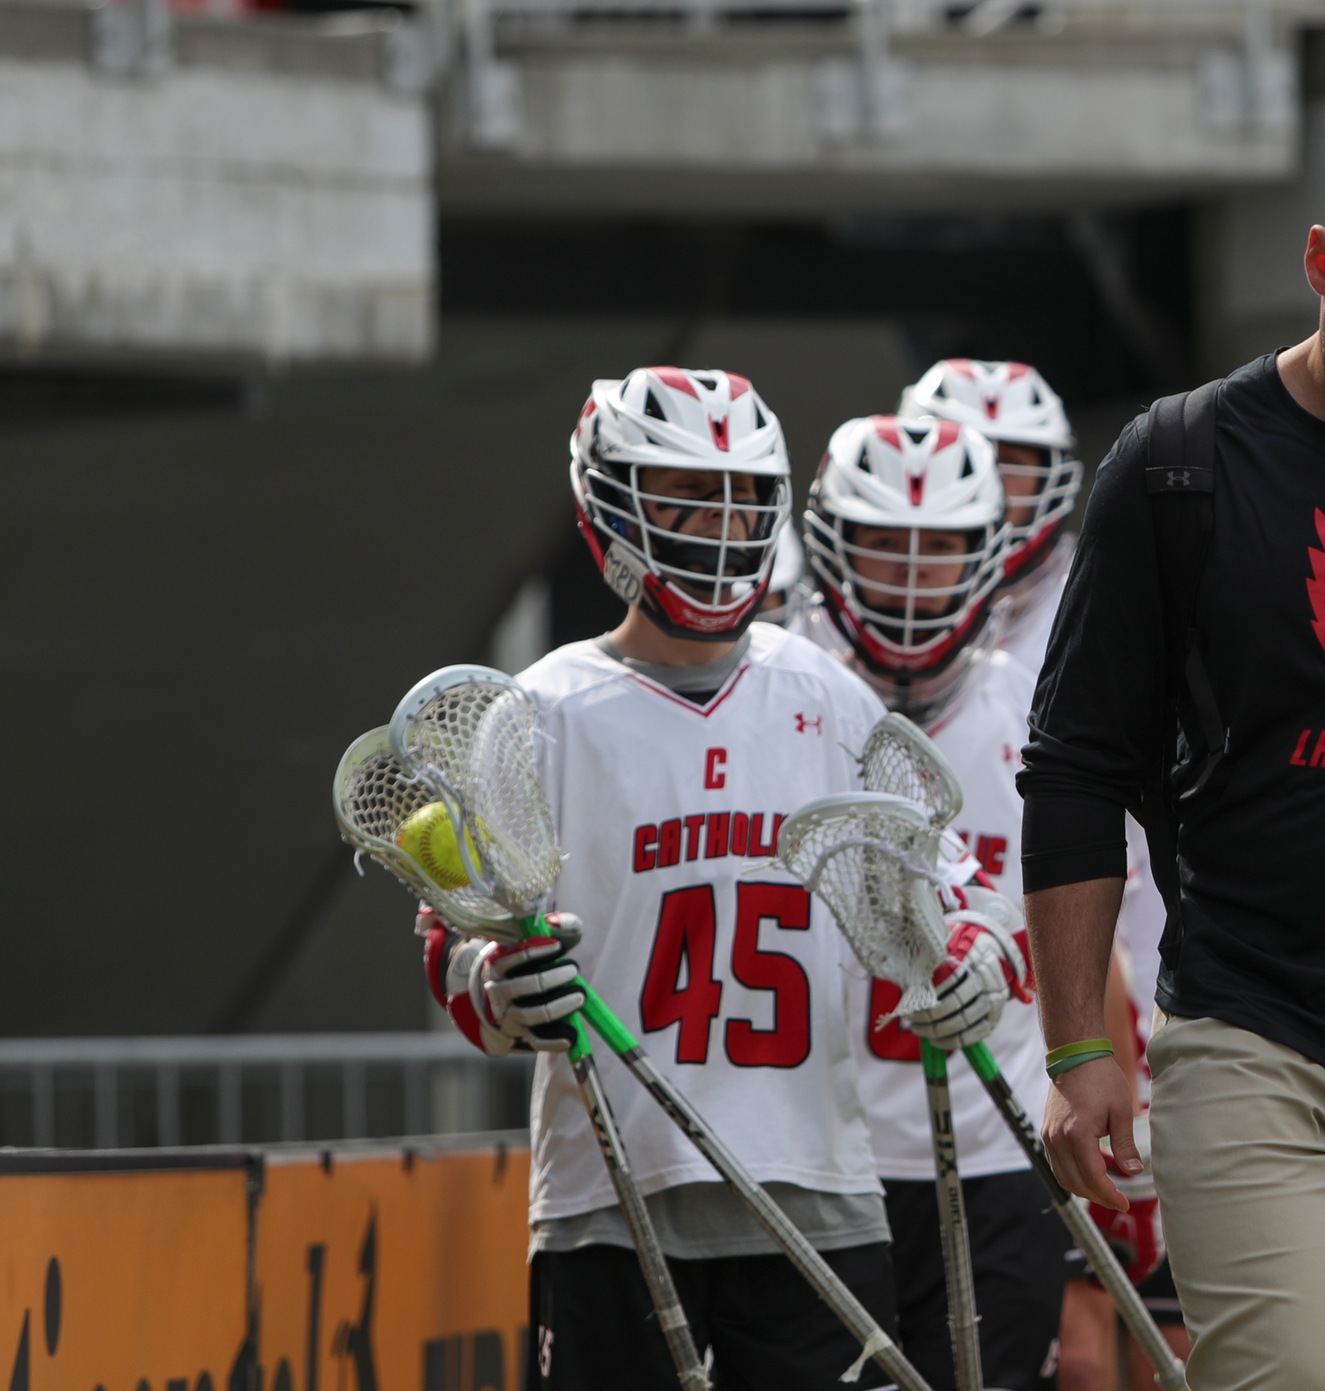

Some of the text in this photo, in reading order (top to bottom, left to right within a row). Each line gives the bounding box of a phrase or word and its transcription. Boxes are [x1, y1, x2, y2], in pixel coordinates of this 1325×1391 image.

[704, 747, 727, 790] C
[633, 811, 791, 873] CATHOLI
[639, 880, 812, 1069] 45
[934, 1110, 957, 1178] STX
